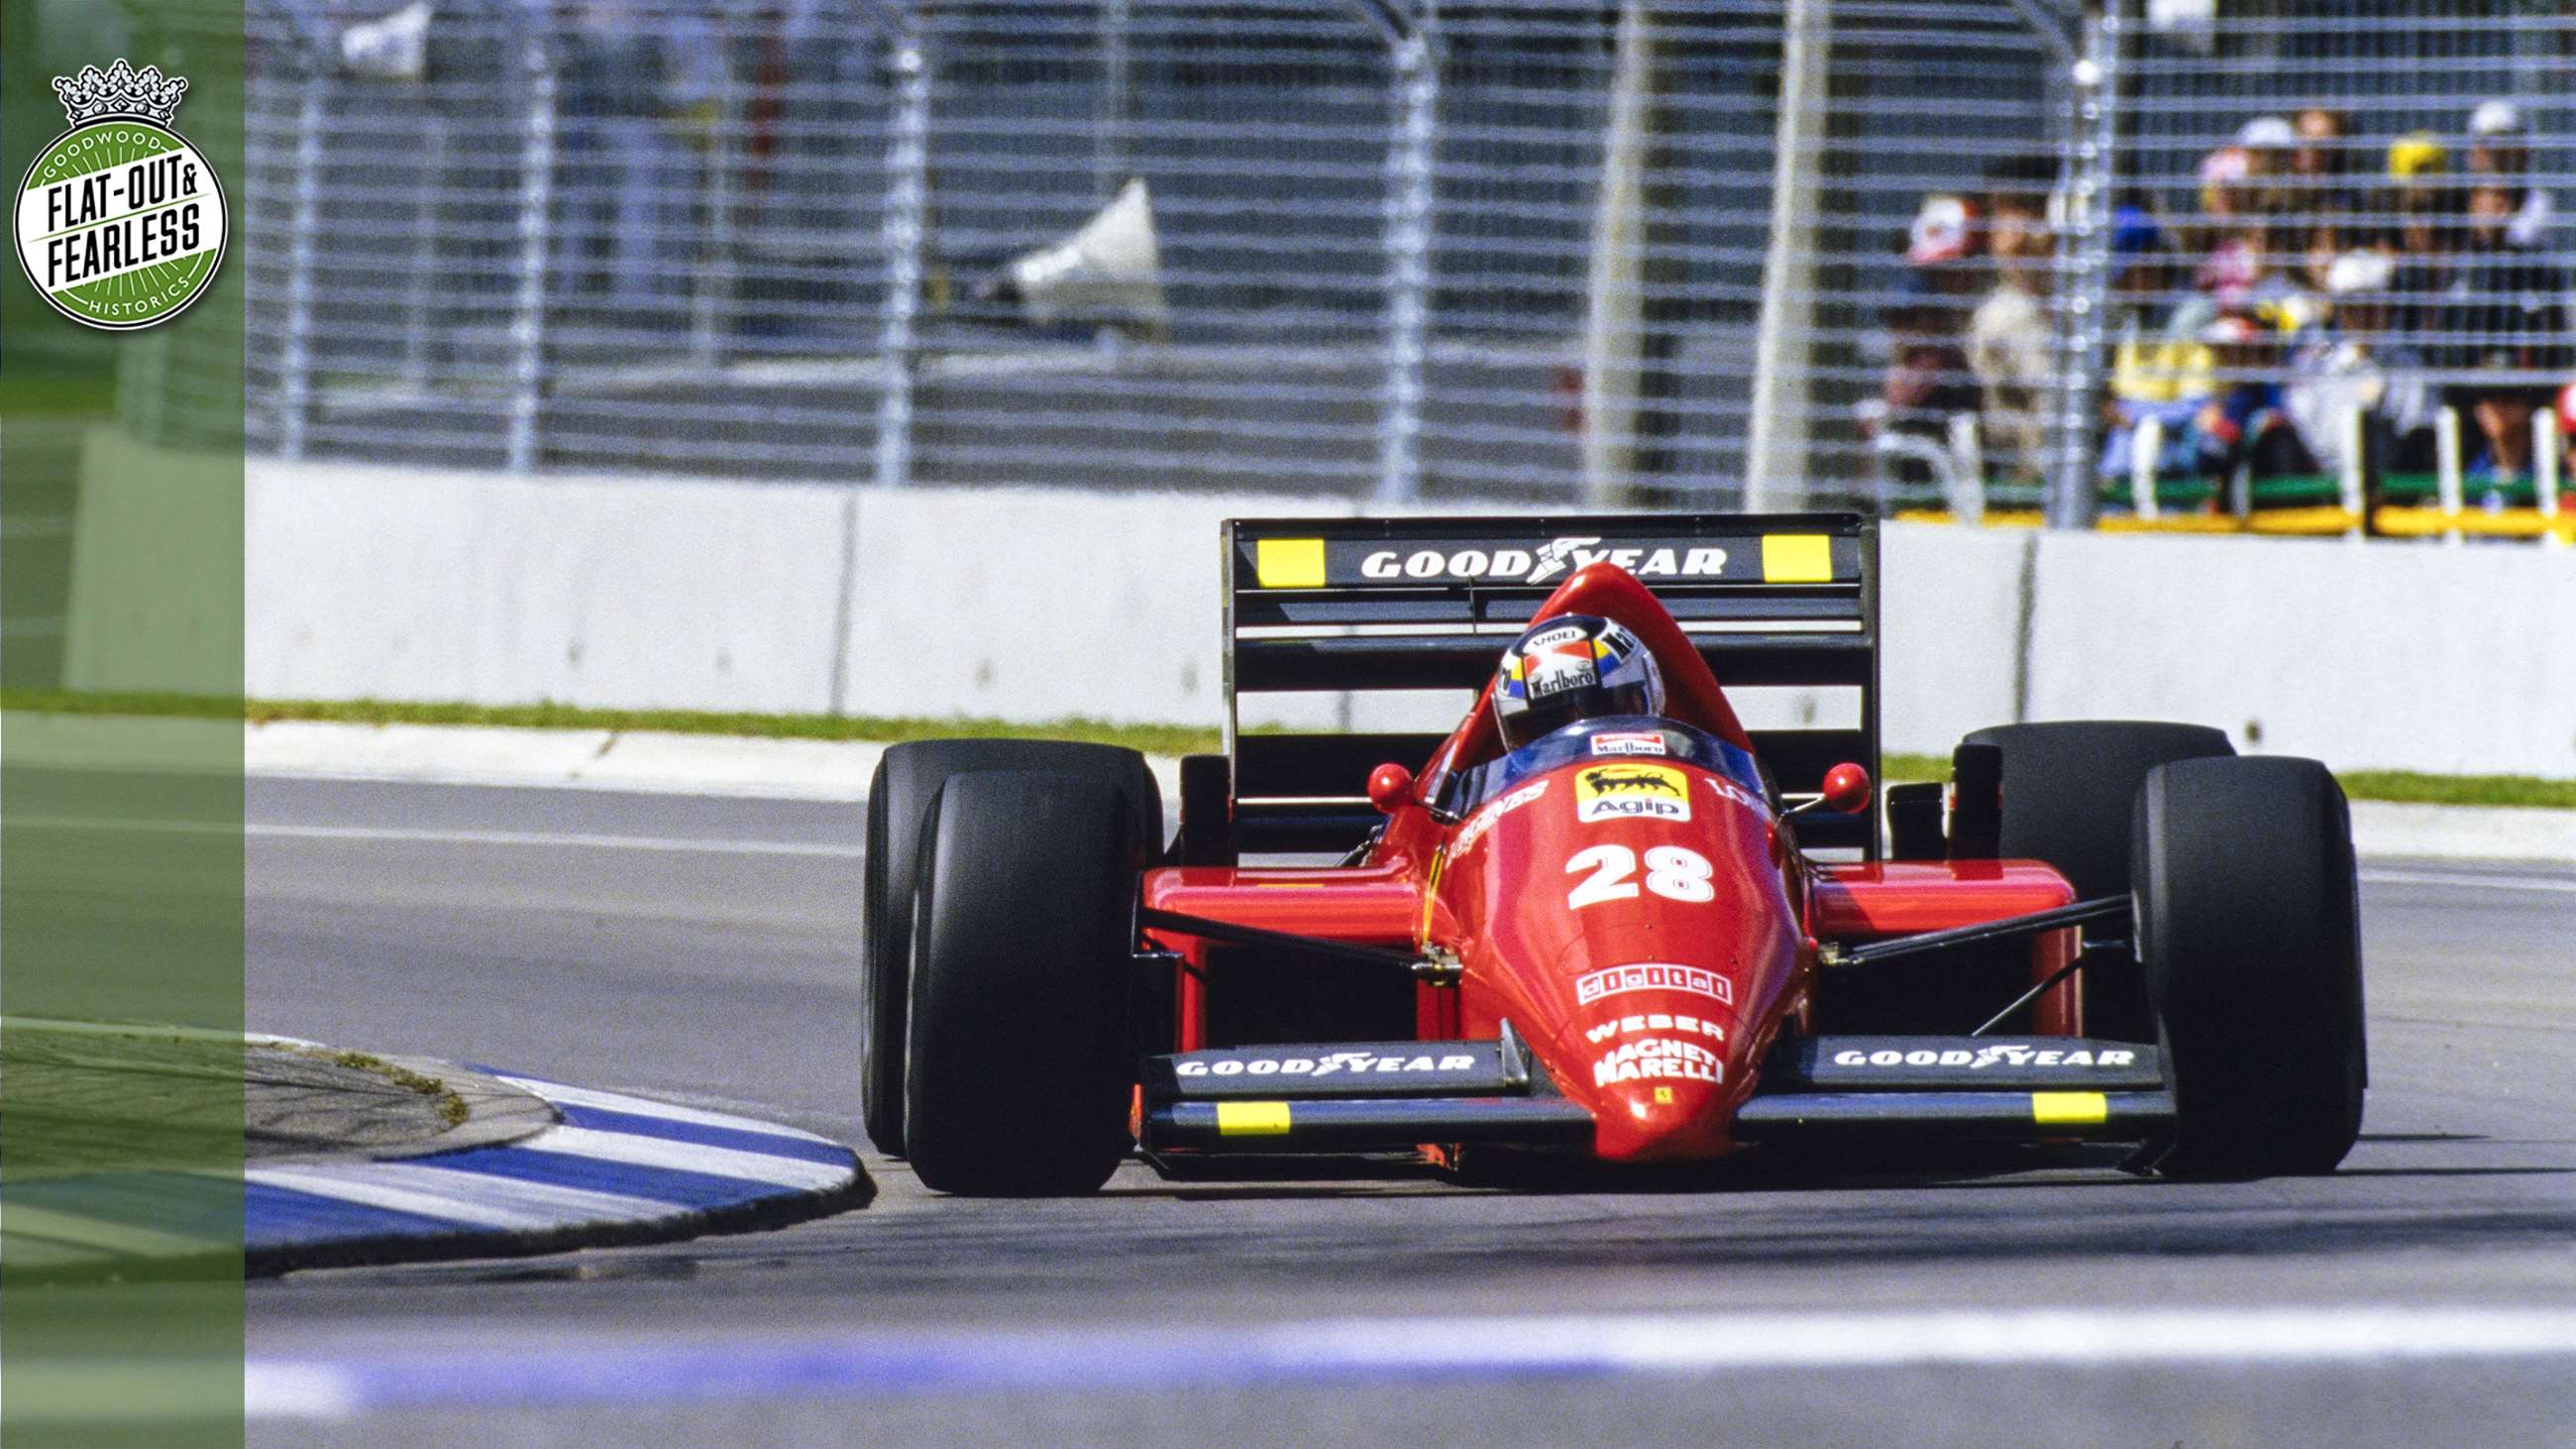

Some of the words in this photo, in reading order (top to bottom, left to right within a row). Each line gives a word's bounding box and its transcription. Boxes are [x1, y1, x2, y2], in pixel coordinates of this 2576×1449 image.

[1531, 669, 1594, 698] Marlboro
[1596, 741, 1664, 754] Marlboro
[1591, 798, 1679, 816] Agip
[1565, 844, 1715, 910] 28
[1581, 965, 1728, 1000] digital
[1585, 1014, 1724, 1044] WEBER
[1176, 1054, 1475, 1076] GOODYEAR
[1833, 1048, 2135, 1067] GOODYEAR
[1593, 1057, 1724, 1088] MARELLI
